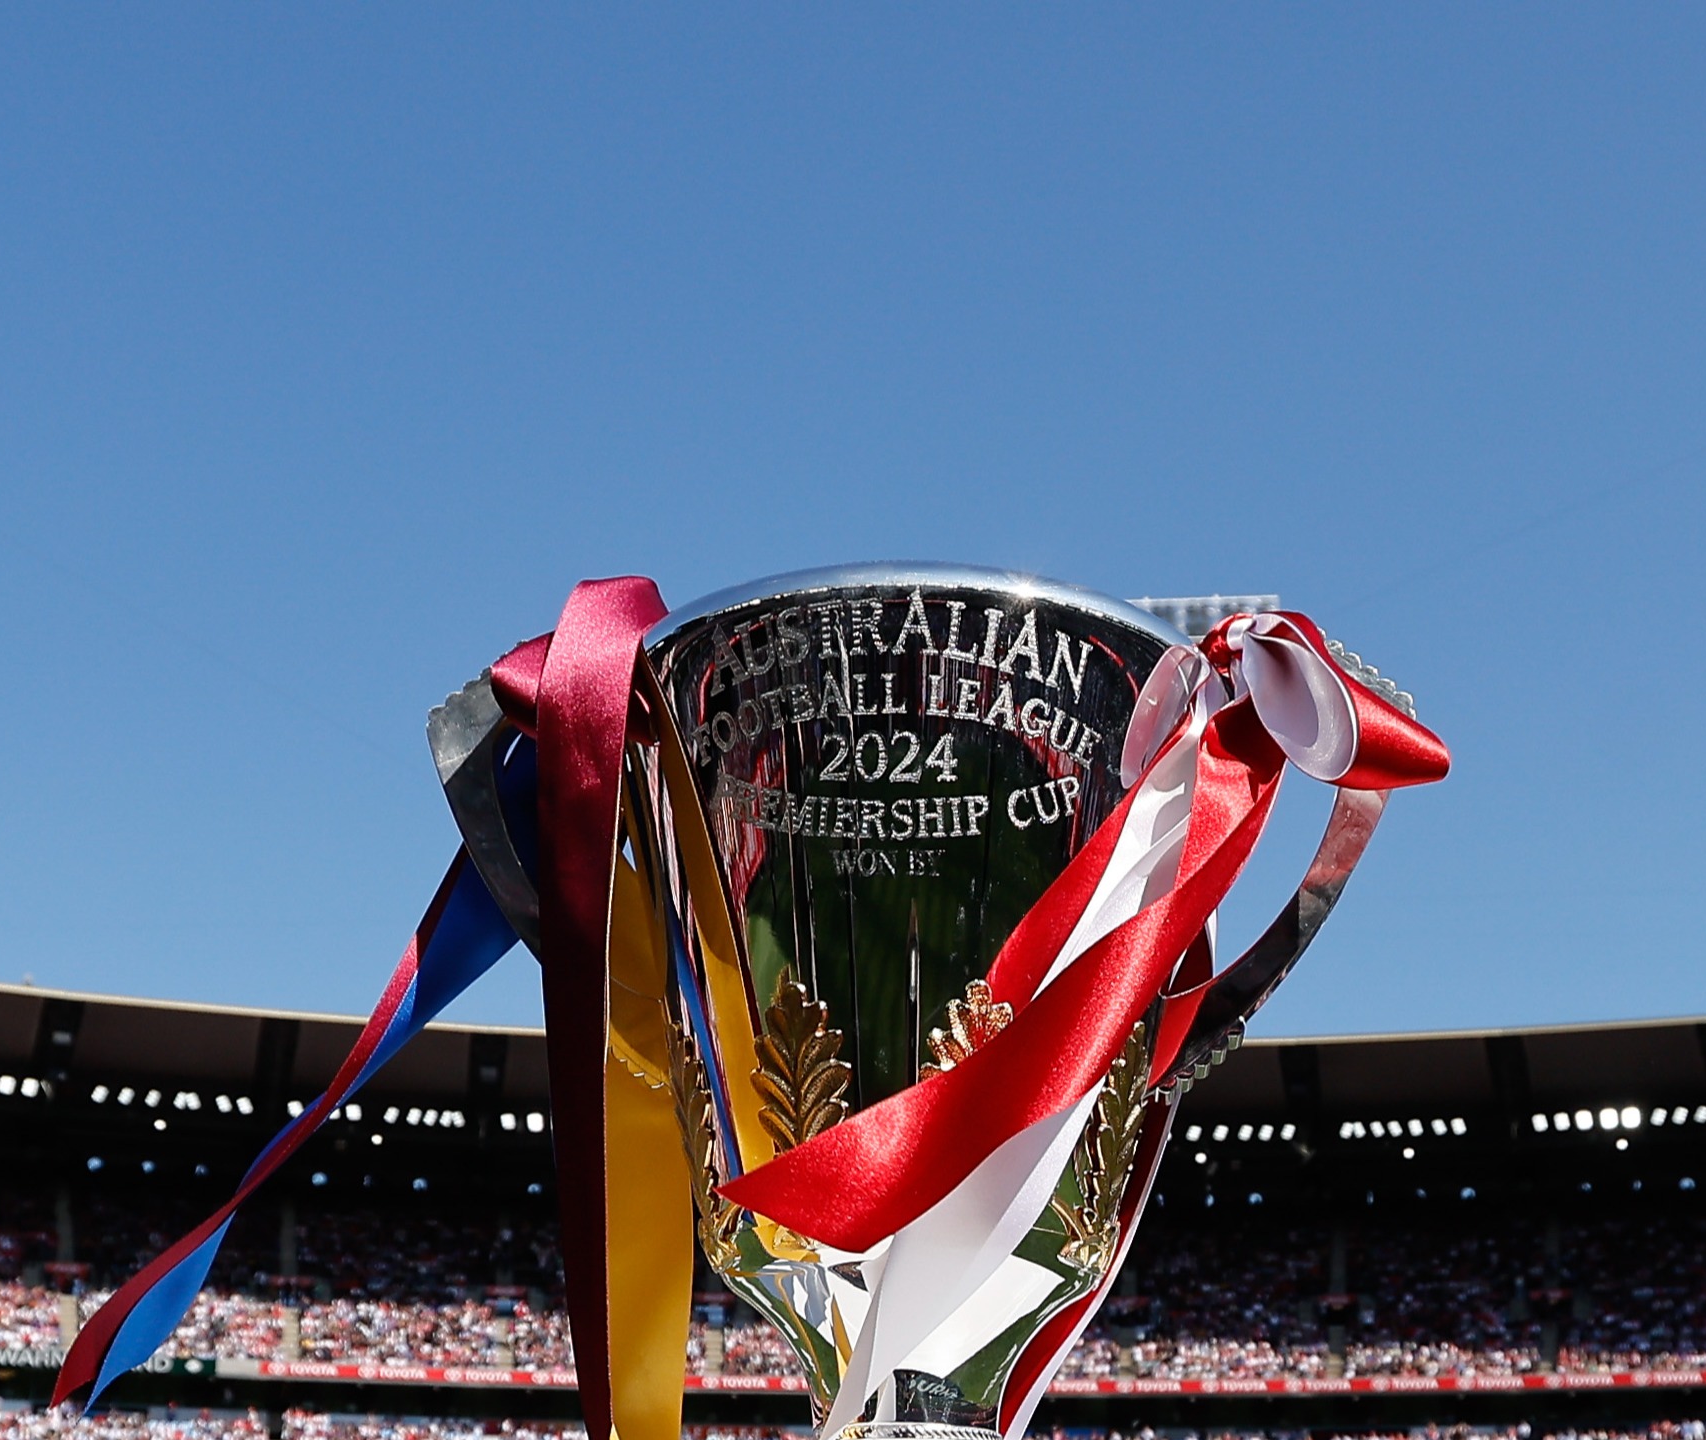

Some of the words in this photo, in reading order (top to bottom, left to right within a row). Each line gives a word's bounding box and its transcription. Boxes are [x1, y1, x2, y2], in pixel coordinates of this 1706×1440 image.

[709, 584, 1093, 705] AUSTRALIAN
[692, 671, 908, 767] FOOTBALL
[925, 673, 1103, 770] LEAGUE
[819, 729, 959, 784] 2024
[711, 769, 990, 841] PREMIERSHIP
[1005, 775, 1081, 830] CUP
[829, 848, 897, 878] WON
[906, 848, 948, 878] BY
[288, 1362, 337, 1376] TOYOTA
[378, 1366, 426, 1380] TOYOTA
[465, 1369, 510, 1383] TOYOTA
[720, 1376, 768, 1389] TOYOTA
[1477, 1376, 1524, 1388] TOYOTA
[1566, 1373, 1614, 1386] TOYOTA
[1653, 1371, 1702, 1384] TOYOTA
[1134, 1380, 1180, 1392] TOYOTA
[1219, 1380, 1267, 1391] TOYOTA
[1304, 1379, 1351, 1390] TOYOTA
[1392, 1378, 1439, 1390] TOYOTA
